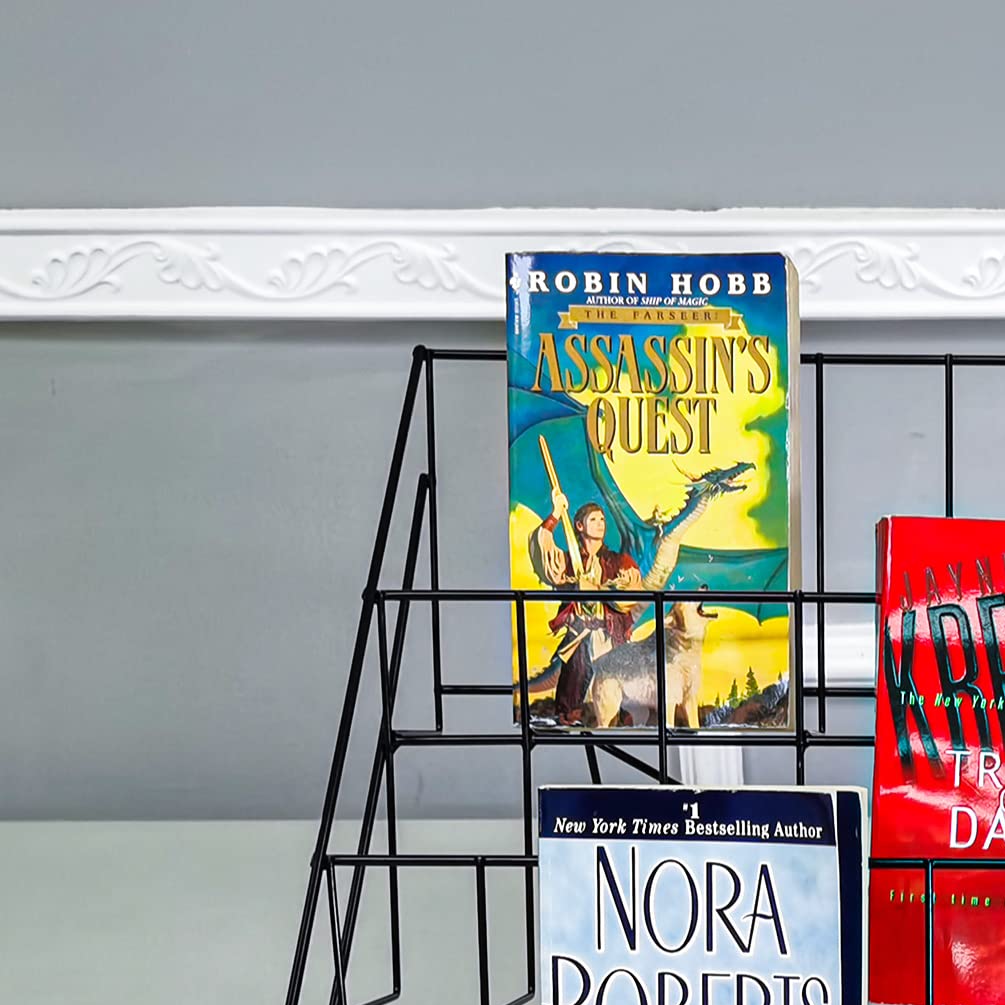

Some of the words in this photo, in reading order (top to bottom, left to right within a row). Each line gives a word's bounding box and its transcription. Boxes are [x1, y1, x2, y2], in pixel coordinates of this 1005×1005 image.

[528, 271, 647, 294] ROBIN
[670, 272, 773, 295] HOBB
[586, 296, 624, 305] AUTHOR
[626, 296, 639, 305] OF
[641, 296, 662, 305] SHIP
[663, 297, 677, 305] OF
[678, 297, 709, 306] MAGIC
[584, 310, 617, 319] THE
[531, 333, 771, 394] ASSASSIN'S
[586, 397, 718, 463] QUEST
[900, 691, 924, 705] The
[934, 693, 962, 708] New
[972, 695, 1004, 710] York
[682, 801, 700, 819] #1
[553, 817, 586, 834] New
[591, 818, 626, 834] York
[632, 818, 679, 835] Times
[684, 819, 770, 839] Bestselling
[773, 822, 823, 839] Author
[596, 845, 788, 955] NORA
[952, 893, 990, 907] time
